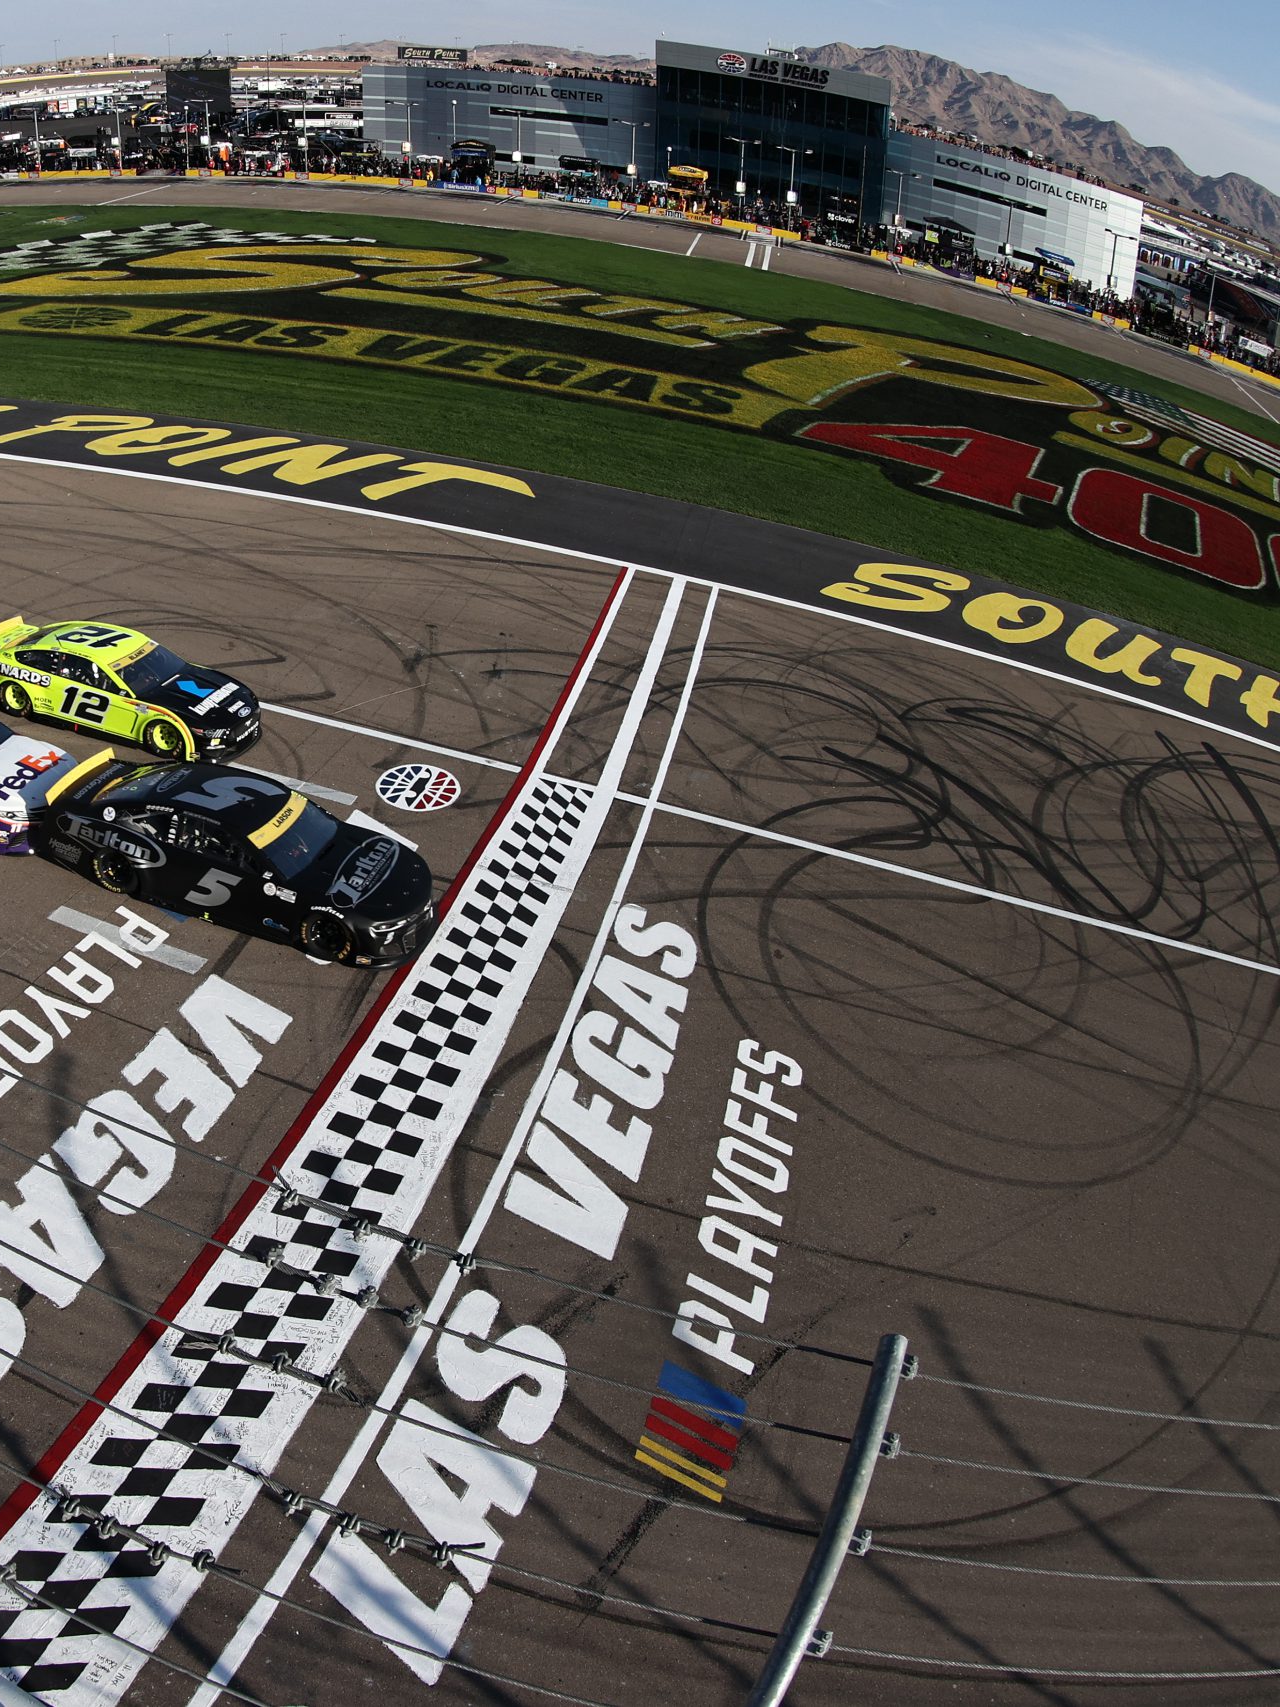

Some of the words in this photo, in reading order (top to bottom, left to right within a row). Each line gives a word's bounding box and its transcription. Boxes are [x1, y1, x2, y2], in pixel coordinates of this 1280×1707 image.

[404, 47, 430, 59] SOUTH
[434, 49, 460, 60] POINT
[751, 57, 779, 75] LAS
[782, 61, 830, 85] VEGAS
[497, 84, 548, 98] DIGITAL
[551, 88, 604, 103] CENTER
[1016, 175, 1063, 198] DIGITAL
[1065, 190, 1108, 212] CENTER
[835, 214, 855, 224] clover
[832, 241, 851, 250] clover
[131, 311, 348, 349] LAS
[357, 334, 743, 415] VEGAS
[55, 625, 134, 649] 12
[128, 648, 146, 661] BLANEY
[34, 696, 52, 704] MOEN
[60, 685, 110, 725] 12
[171, 776, 288, 811] 5
[10, 822, 24, 833] 11
[272, 807, 294, 829] LARSON
[68, 811, 152, 863] Tarlton
[184, 867, 244, 907] 5
[325, 840, 393, 906] Tarlton
[310, 905, 345, 920] GOODYEAR
[505, 904, 698, 1261] VEGAS
[672, 1038, 804, 1375] PLAYOFFS
[310, 1288, 569, 1688] LAS
